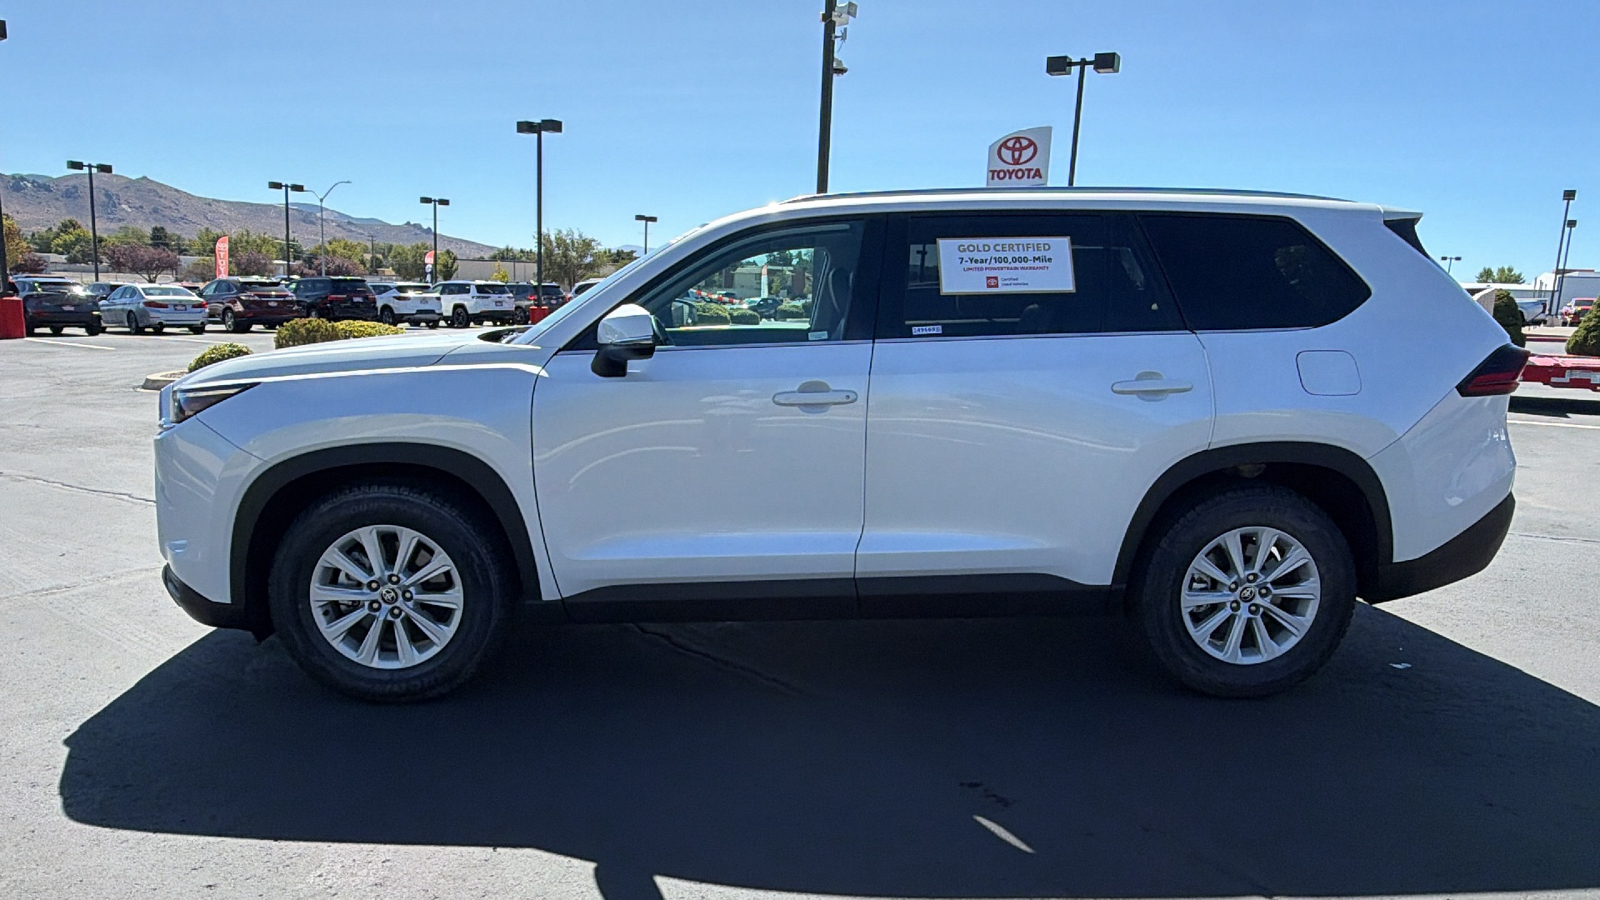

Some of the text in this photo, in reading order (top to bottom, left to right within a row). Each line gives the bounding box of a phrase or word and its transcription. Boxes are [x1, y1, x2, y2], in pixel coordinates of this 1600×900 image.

[989, 168, 1042, 180] TOYOTA
[957, 242, 1051, 253] GOLD CERTIFIED
[958, 255, 1053, 265] 7-Year/100,000-Mile
